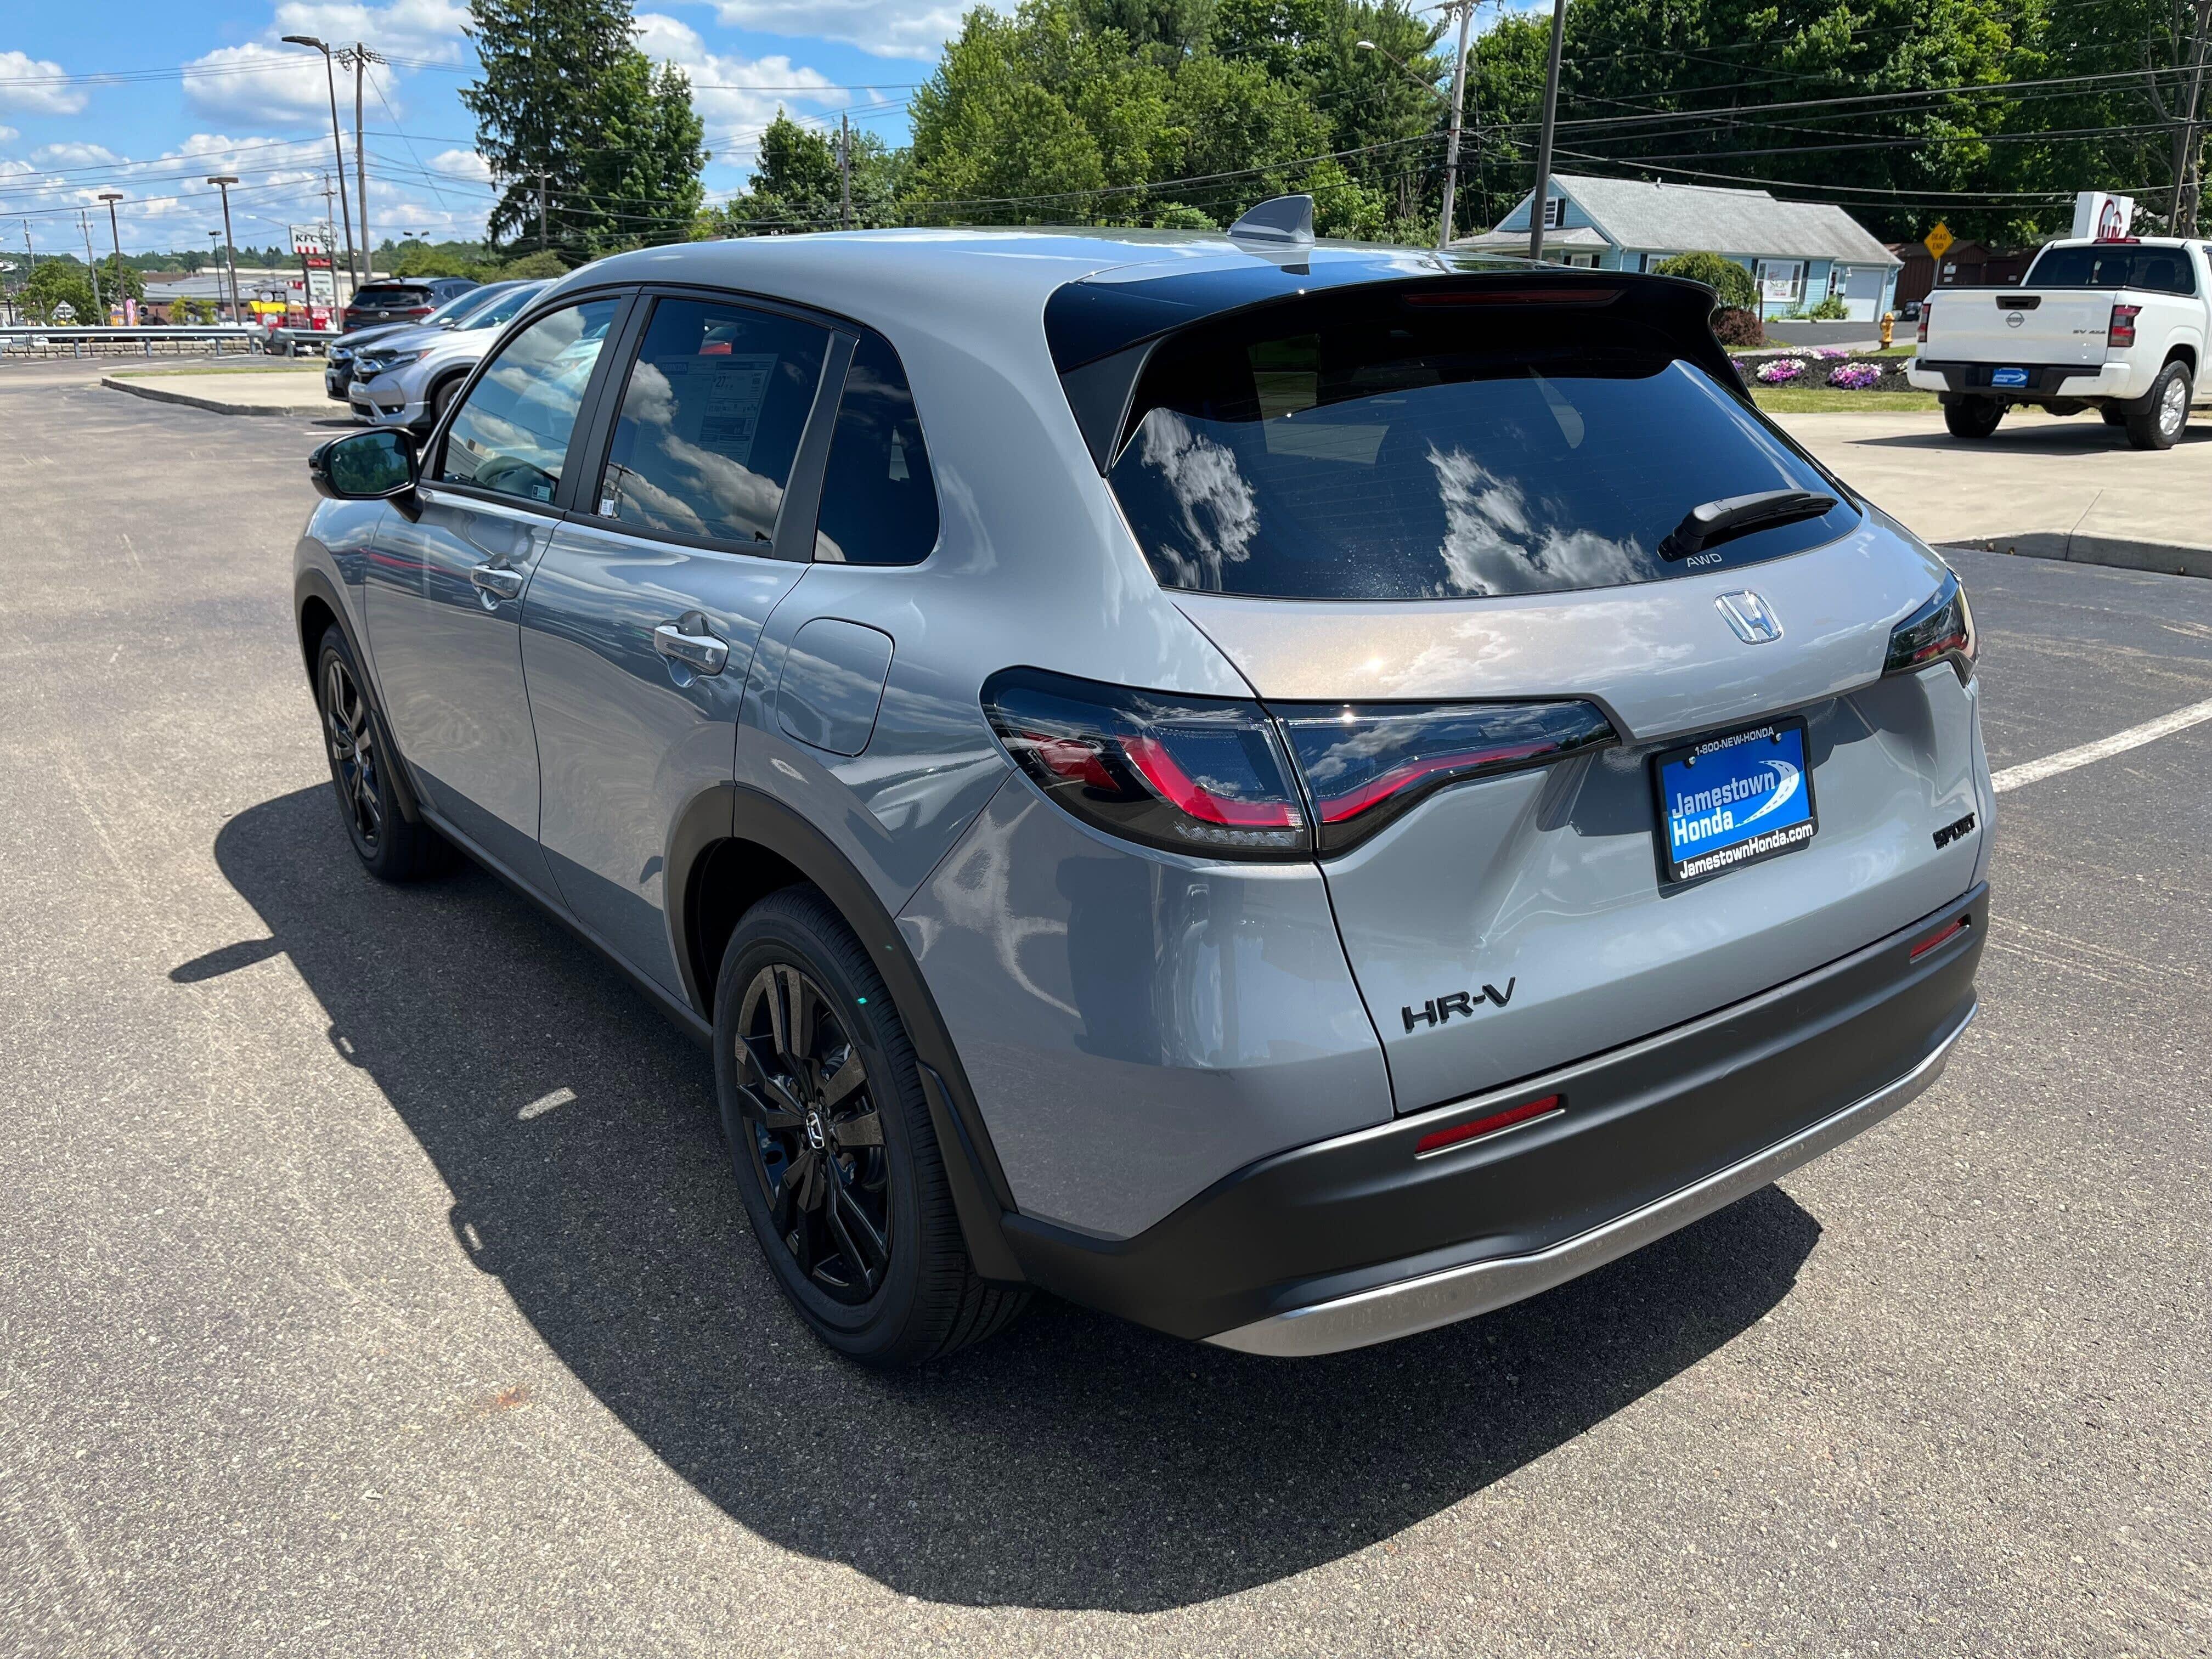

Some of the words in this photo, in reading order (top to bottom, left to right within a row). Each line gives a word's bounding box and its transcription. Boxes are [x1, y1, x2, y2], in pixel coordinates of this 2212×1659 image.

[295, 234, 318, 242] KFC
[1686, 553, 1723, 567] AWD
[1695, 726, 1775, 756] 1-800-NEW-HONDA
[1672, 771, 1775, 819] Jamestown
[1673, 807, 1734, 847] Honda
[1679, 822, 1813, 879] JamestownHonda.com
[1401, 977, 1516, 1034] HR-V
